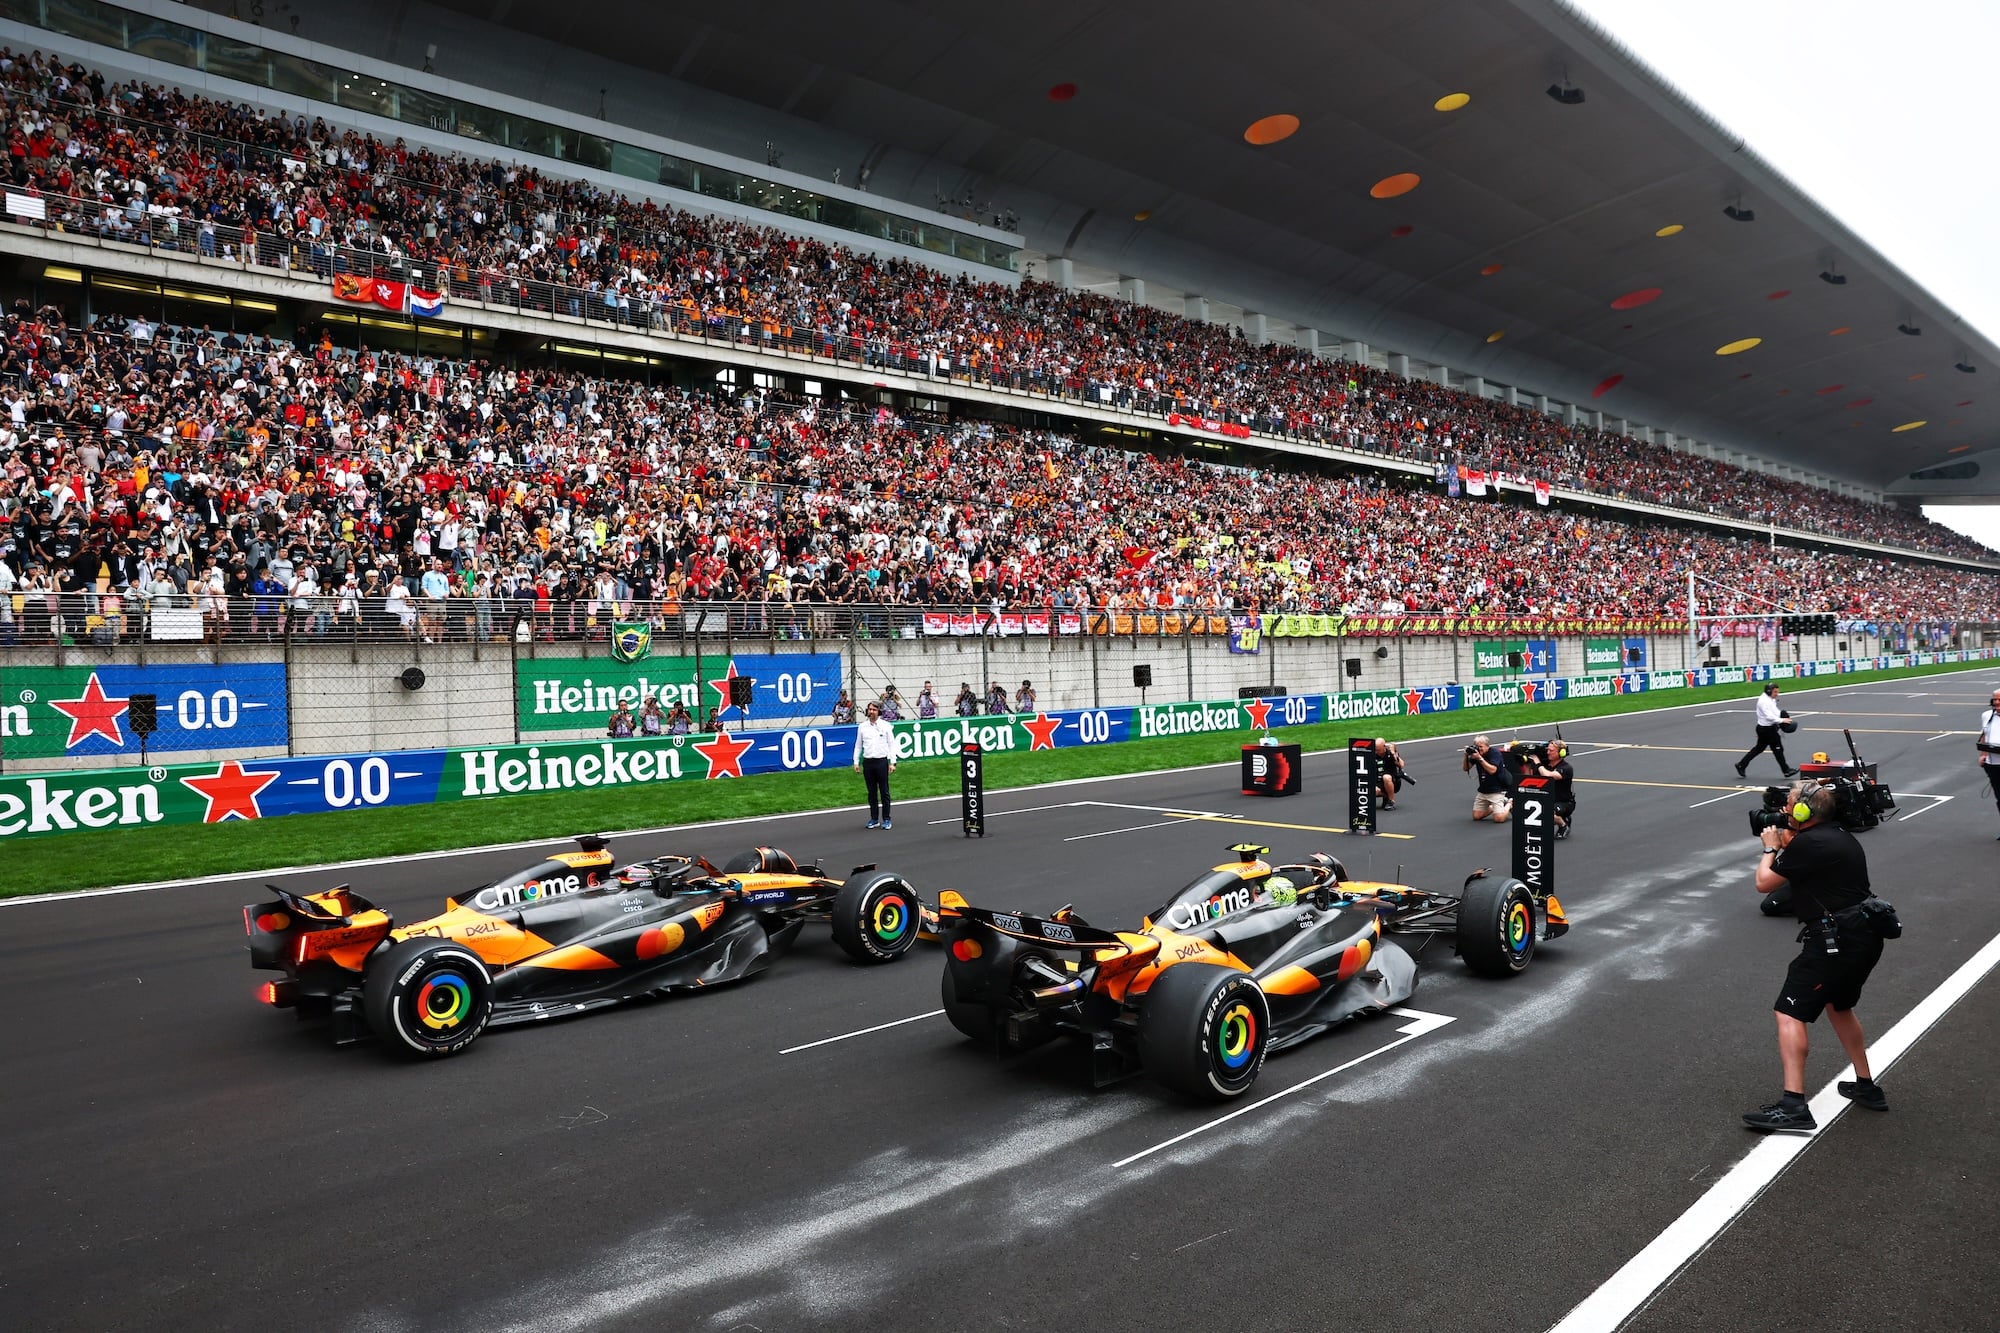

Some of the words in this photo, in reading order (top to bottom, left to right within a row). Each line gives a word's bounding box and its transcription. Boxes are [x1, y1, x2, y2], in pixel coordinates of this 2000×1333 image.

[1239, 628, 1259, 650] 81
[777, 673, 812, 703] 0.0
[1431, 687, 1449, 711] 0.0
[1463, 684, 1519, 708] Heineken
[1544, 681, 1556, 700] 0.0
[178, 689, 238, 730] 0.0
[1285, 697, 1306, 725] 0.0
[1327, 691, 1400, 721] Heineken
[1080, 711, 1109, 743] 0.0
[1139, 703, 1240, 738] Heineken
[781, 729, 824, 769] 0.0
[461, 743, 683, 796] Heineken
[966, 760, 977, 779] 3
[1356, 756, 1368, 775] 1
[323, 757, 390, 808] 0.0
[1524, 800, 1542, 826] 2
[1525, 832, 1542, 886] MOËT
[474, 874, 580, 911] Chrome
[764, 891, 785, 899] WORLD
[1167, 887, 1250, 930] Chrome
[465, 922, 500, 937] DELL
[994, 917, 1020, 930] OXXO
[1044, 926, 1073, 939] OXXO
[1175, 942, 1204, 960] DELL
[1203, 986, 1226, 1037] ZERO
[1202, 1040, 1209, 1054] P
